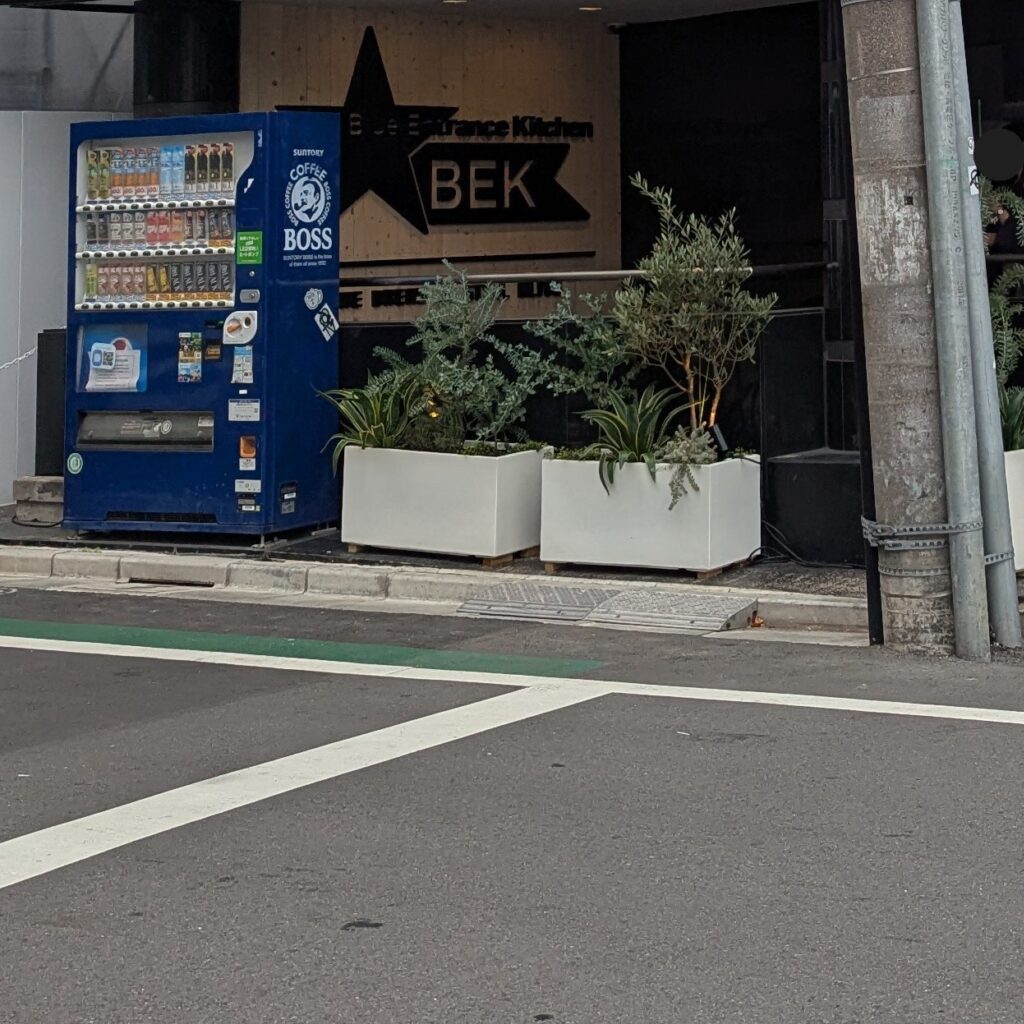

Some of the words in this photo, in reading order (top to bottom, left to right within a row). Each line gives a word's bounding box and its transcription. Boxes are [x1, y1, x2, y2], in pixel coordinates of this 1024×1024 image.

[293, 148, 324, 157] SUNTORY
[290, 162, 328, 182] COFFEE
[431, 160, 536, 210] BEK
[283, 227, 332, 251] BOSS
